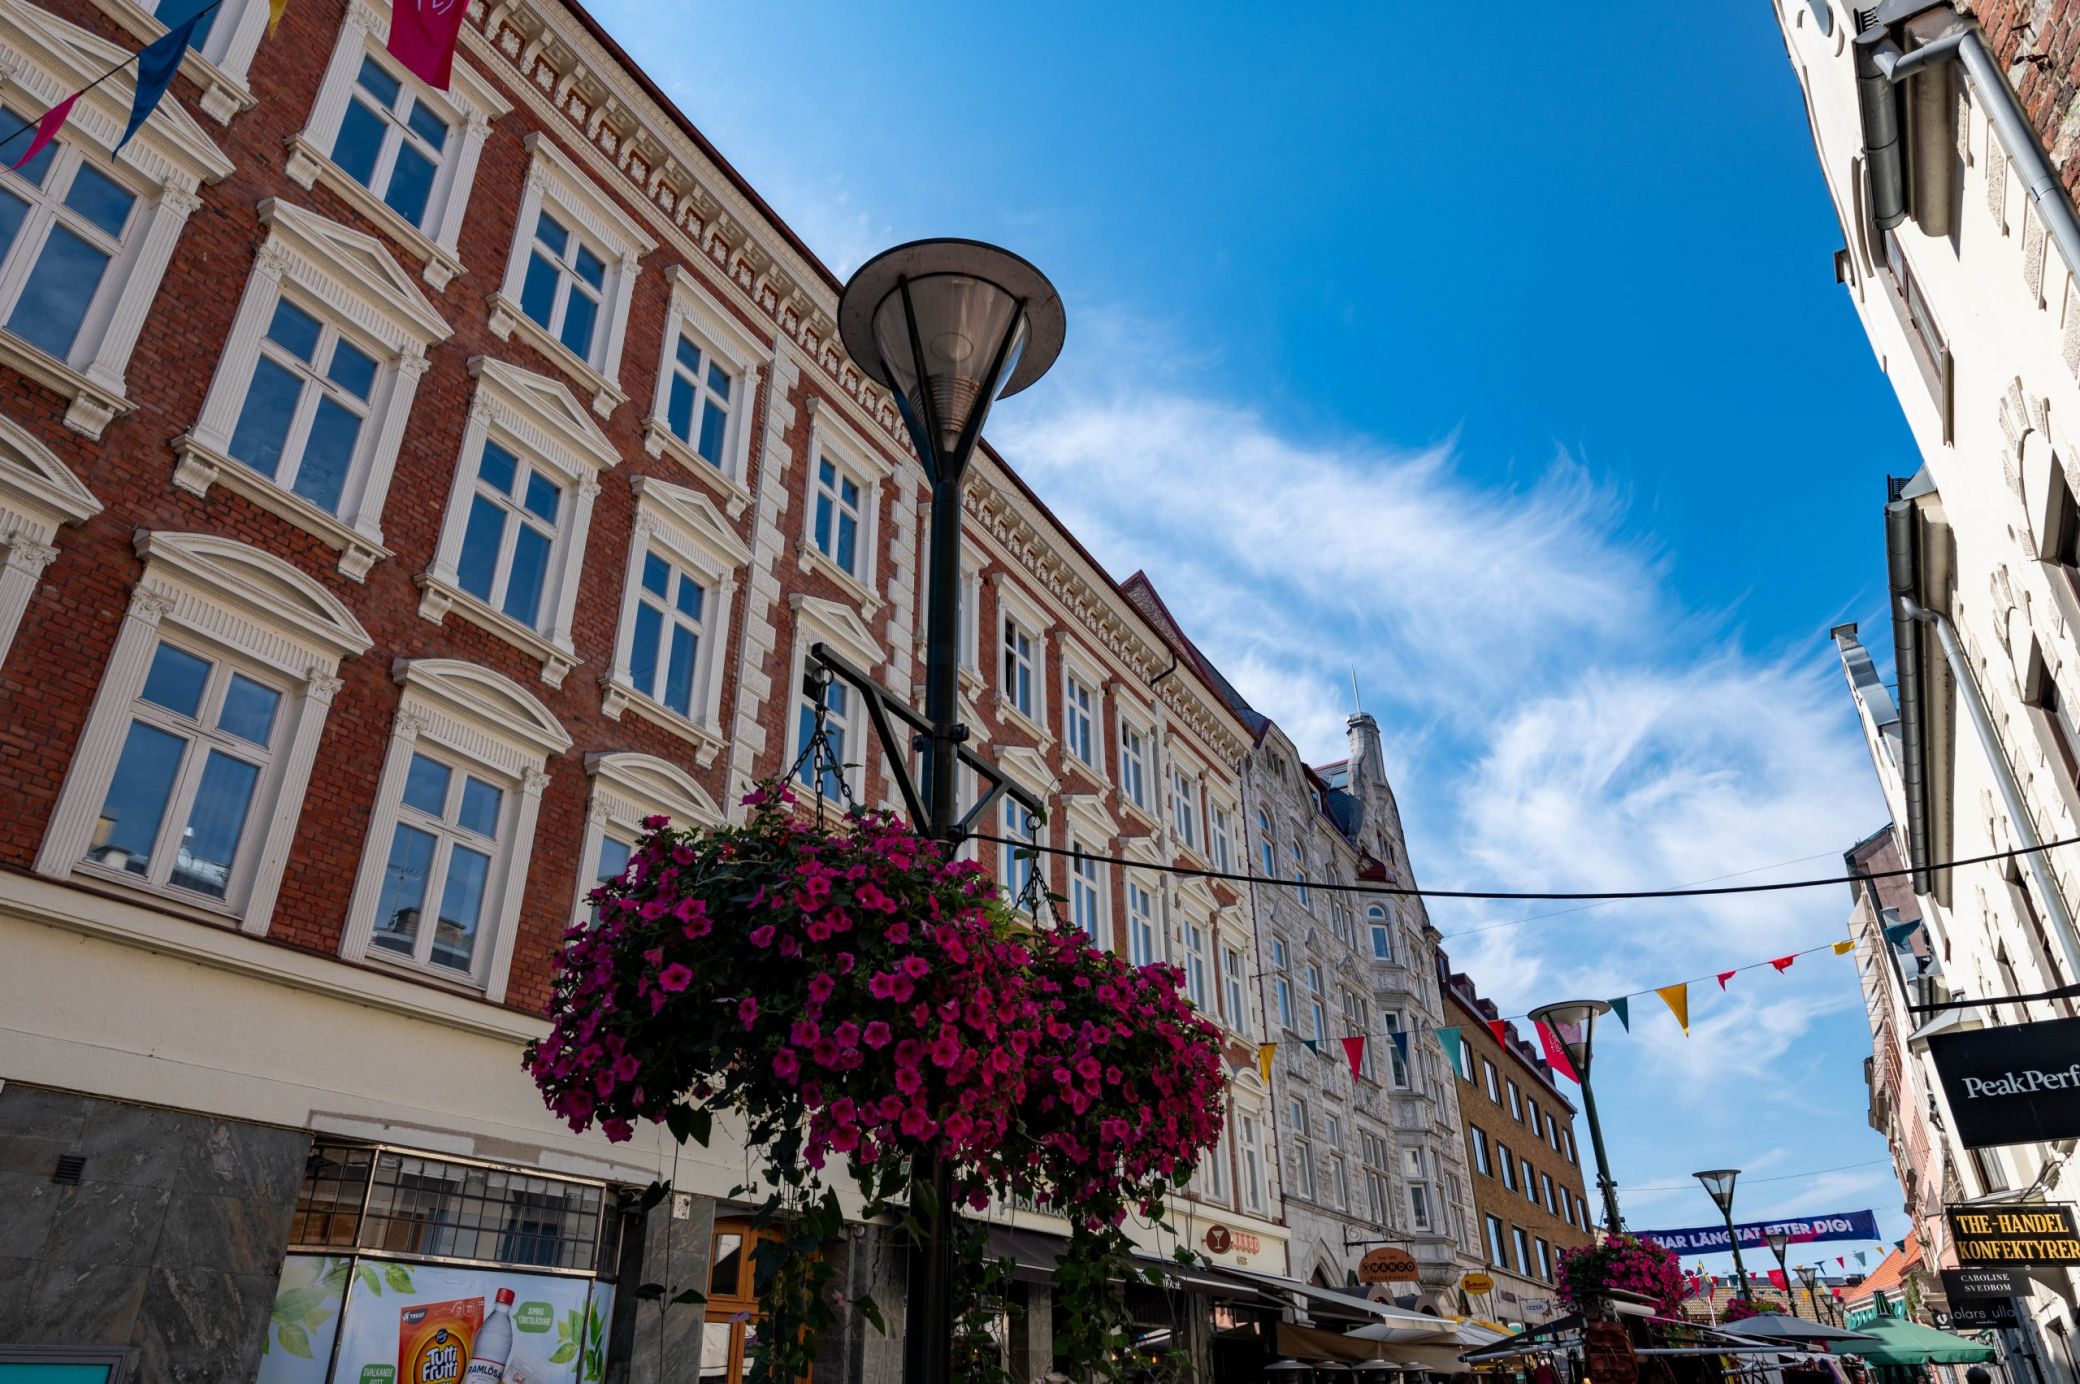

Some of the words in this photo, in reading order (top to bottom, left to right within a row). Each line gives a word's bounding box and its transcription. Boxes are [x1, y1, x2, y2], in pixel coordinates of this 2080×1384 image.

[1652, 1235, 1688, 1249] HAR
[1764, 1222, 1812, 1236] EFTER
[1813, 1218, 1854, 1233] DIG!
[1957, 1213, 2069, 1234] THE-HANDEL
[1957, 1239, 2080, 1260] KONFEKTYRER
[1960, 1273, 2010, 1282] CAROLINE
[1964, 1283, 2012, 1292] SVEDBOM
[426, 1345, 457, 1367] Tutti
[422, 1360, 458, 1382] Frutti
